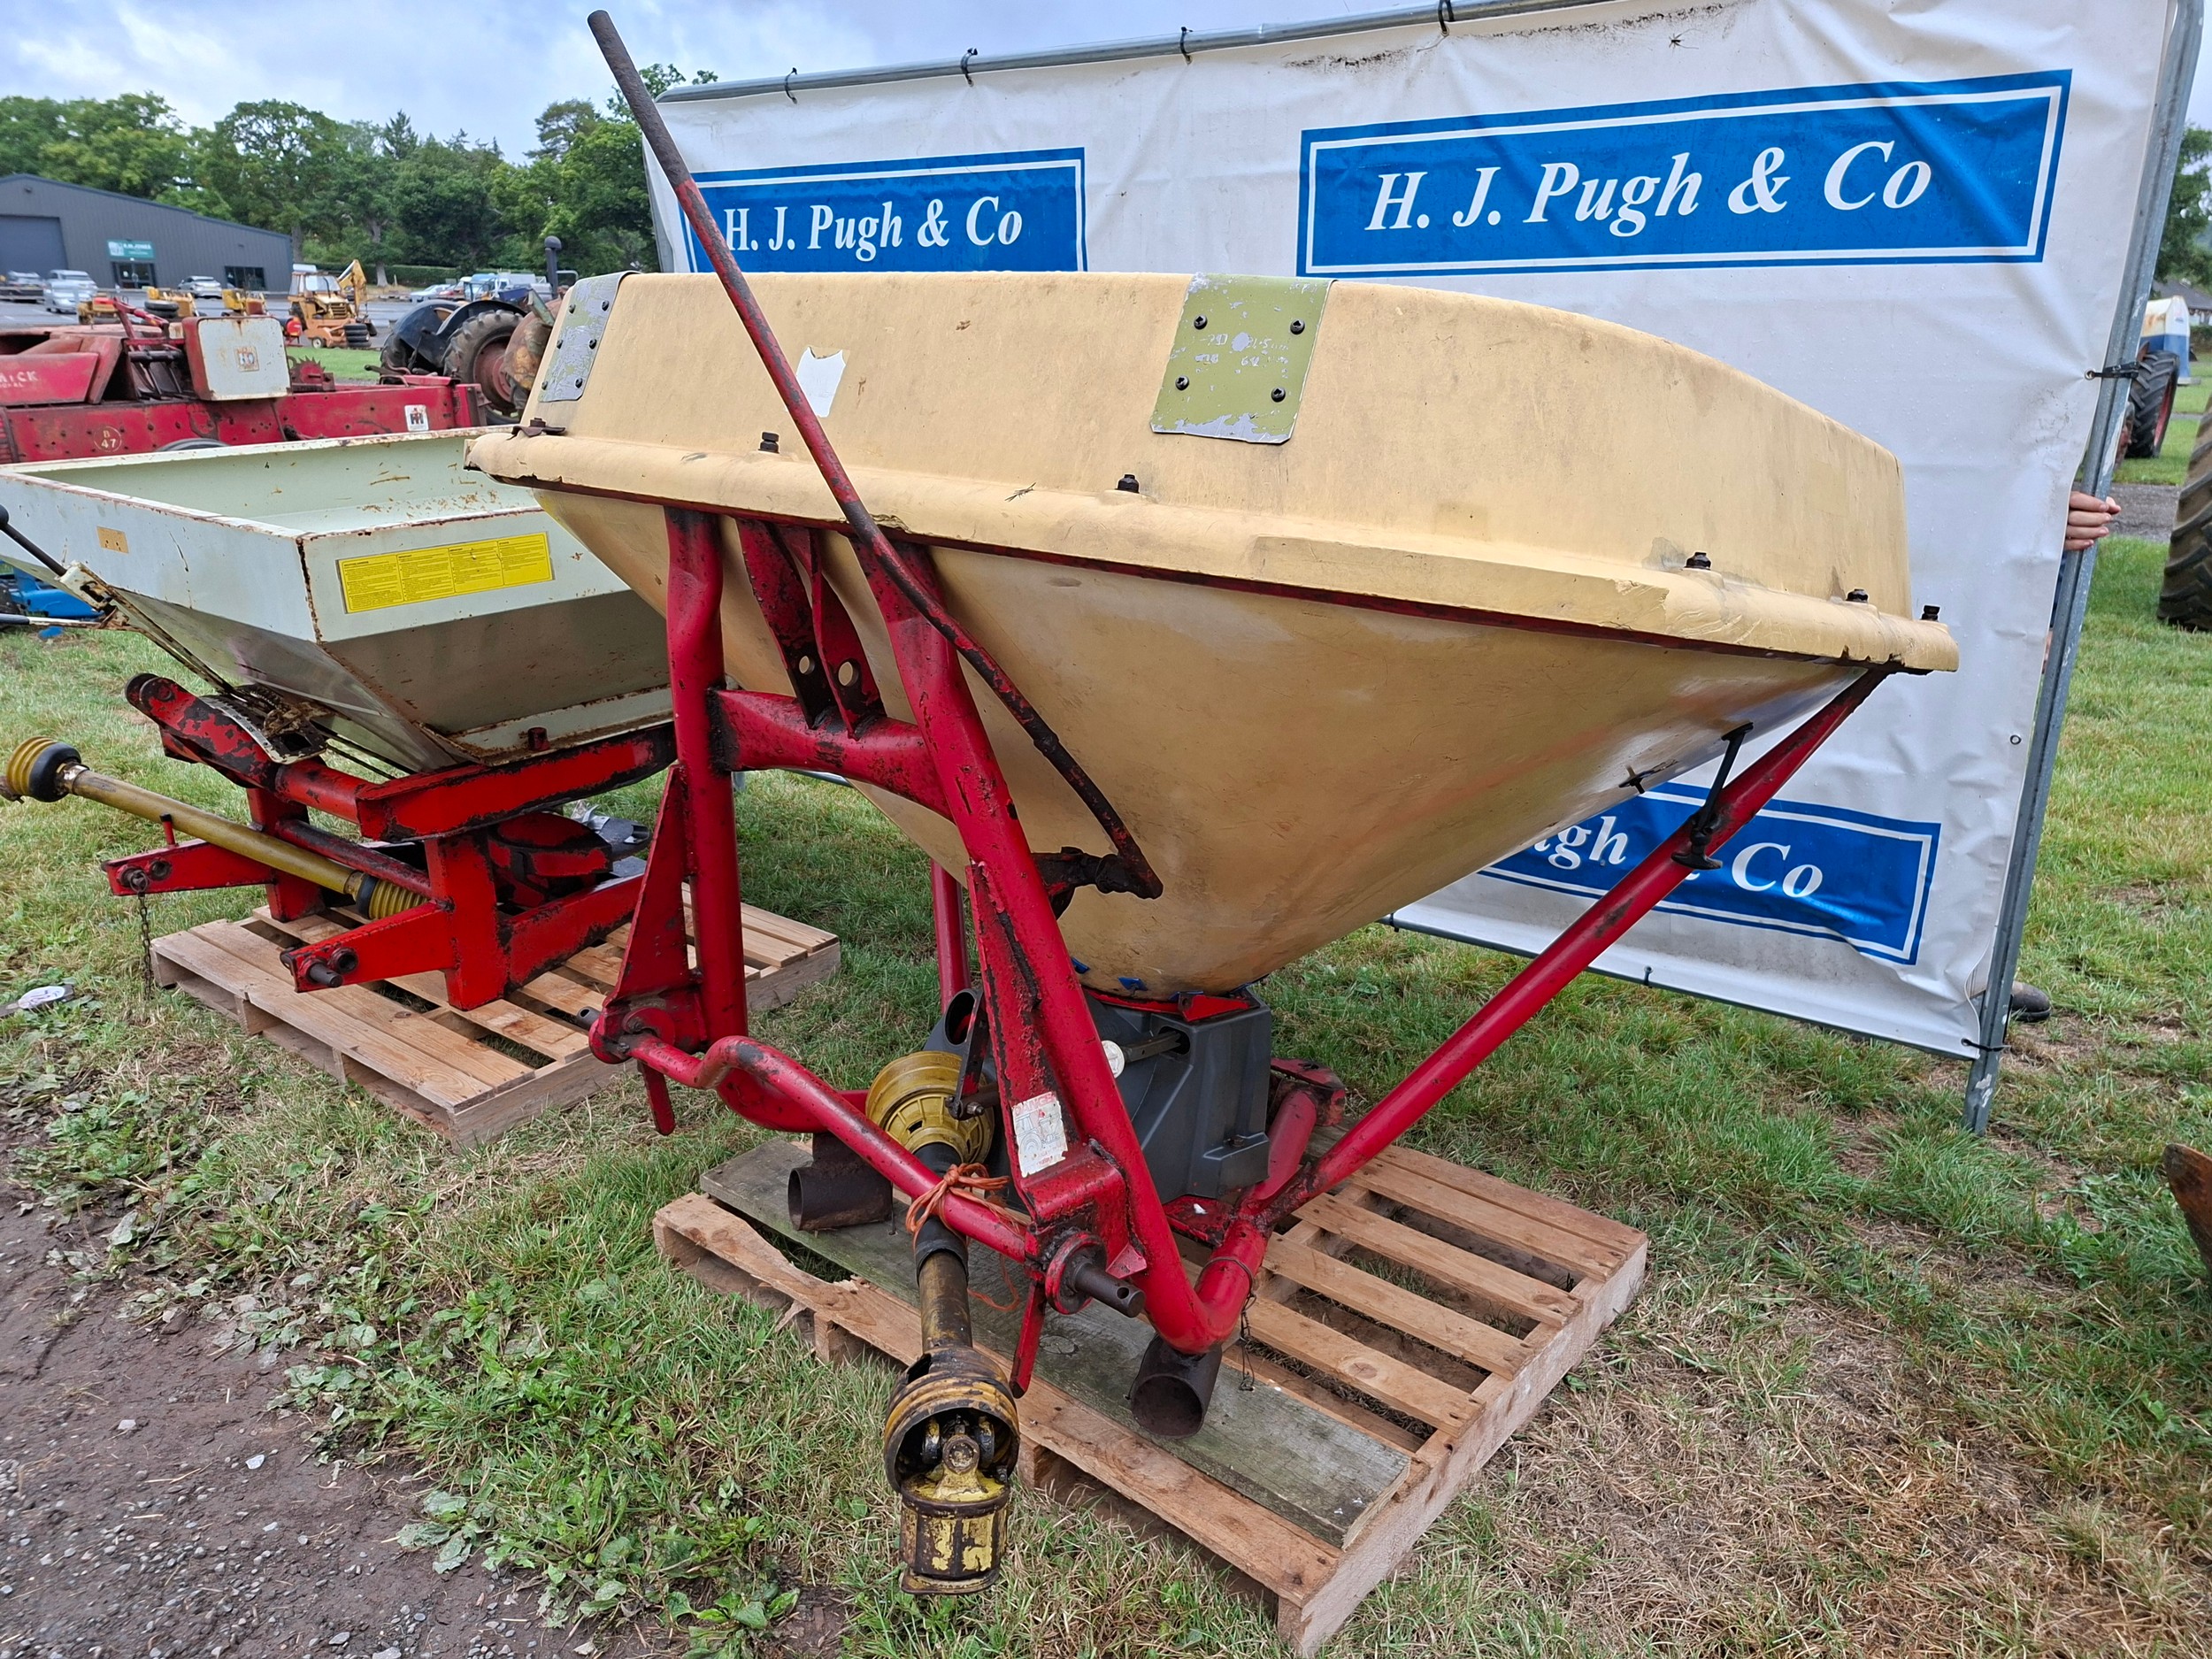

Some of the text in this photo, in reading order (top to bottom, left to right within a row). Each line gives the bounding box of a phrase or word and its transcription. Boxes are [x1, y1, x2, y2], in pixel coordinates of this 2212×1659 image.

[1364, 141, 1932, 237] H. J. Pugh & Co
[724, 196, 1023, 262] H. J. Pugh & Co
[101, 438, 117, 449] 47
[1534, 816, 1824, 898] gh Co
